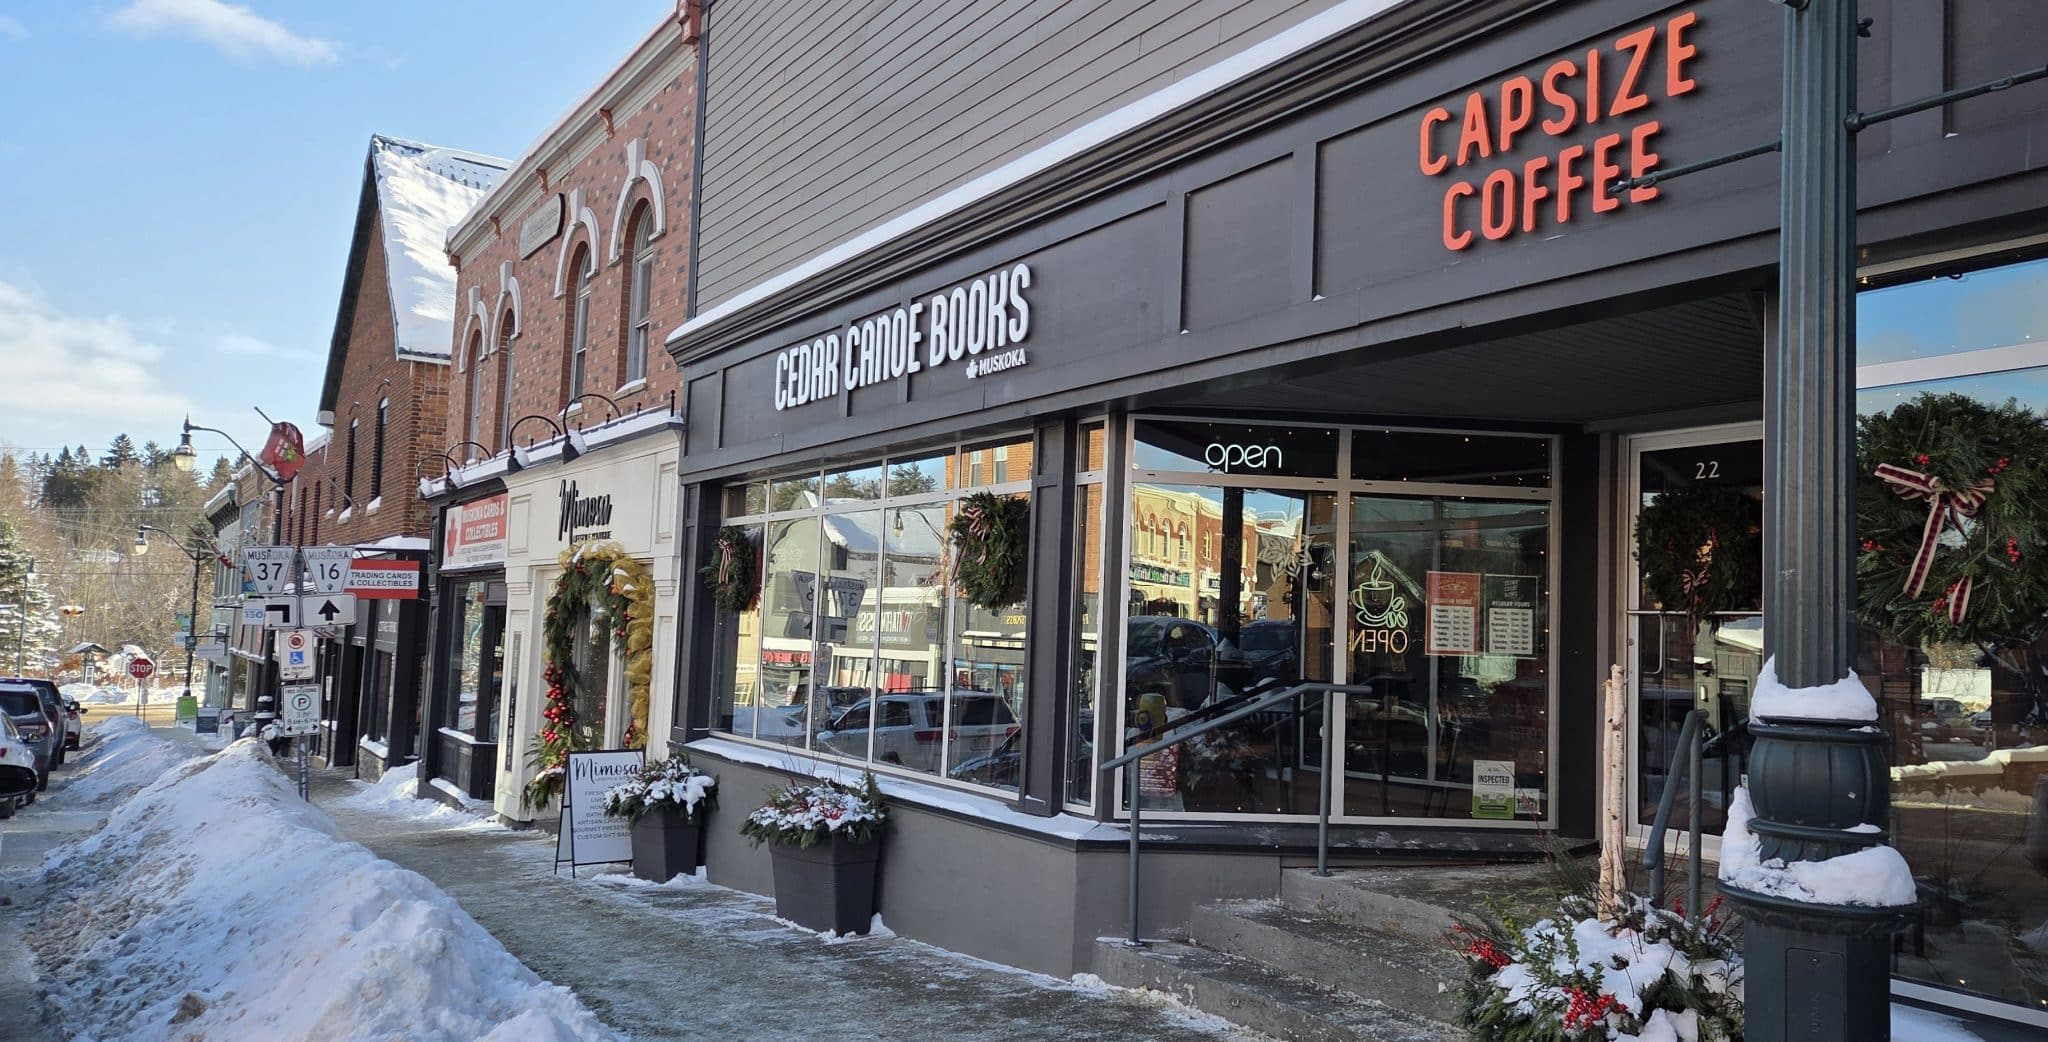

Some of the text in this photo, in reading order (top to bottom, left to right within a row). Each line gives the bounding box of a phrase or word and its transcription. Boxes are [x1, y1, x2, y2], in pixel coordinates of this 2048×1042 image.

[1419, 11, 1697, 176] CAPSIZE
[1442, 120, 1661, 250] COFFEE
[774, 263, 1031, 411] CEDAR CANOE BOOKS
[978, 348, 1027, 377] MUSKOKA
[1205, 443, 1282, 473] open
[1695, 461, 1720, 479] 22
[558, 479, 612, 545] Mimosa
[247, 551, 290, 561] MUSKOKA
[308, 551, 349, 560] MUSKOKA
[257, 563, 283, 580] 37
[319, 563, 340, 580] 16
[386, 572, 412, 580] CARDS
[357, 579, 413, 588] COLLECTIBLES
[130, 663, 153, 673] STOP
[572, 757, 639, 784] Mimosa
[1477, 775, 1510, 784] INSPECTED
